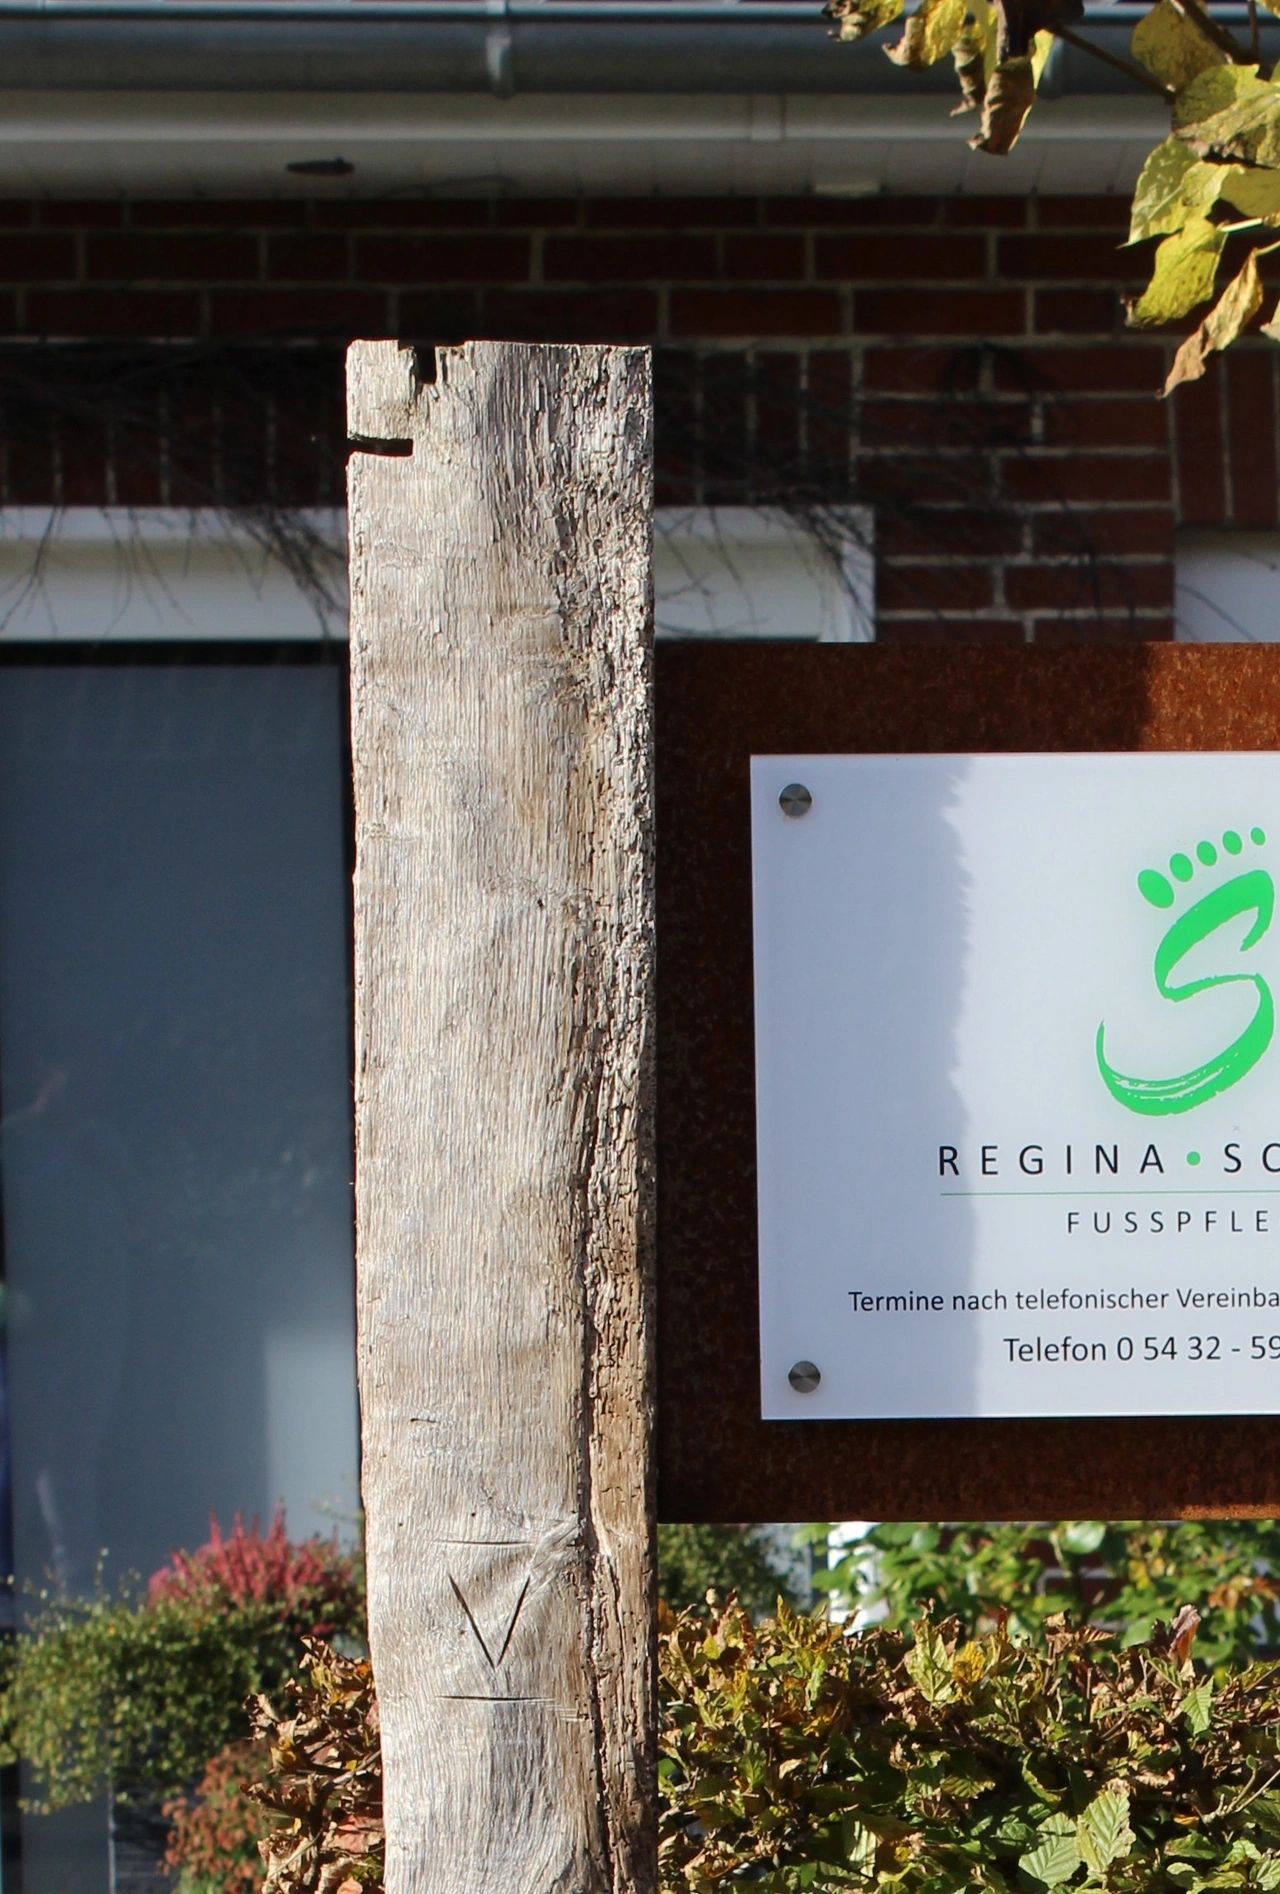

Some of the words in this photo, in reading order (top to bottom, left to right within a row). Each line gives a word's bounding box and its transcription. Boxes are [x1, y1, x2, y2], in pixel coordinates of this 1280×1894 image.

[938, 1143, 1166, 1177] REGINA
[847, 1289, 945, 1313] Termine
[951, 1288, 1008, 1312] nach
[1014, 1287, 1170, 1311] telefonischer
[1002, 1335, 1108, 1363] Telefon
[1116, 1336, 1135, 1363] 0
[1143, 1335, 1178, 1362] 54
[1187, 1335, 1222, 1361] 32
